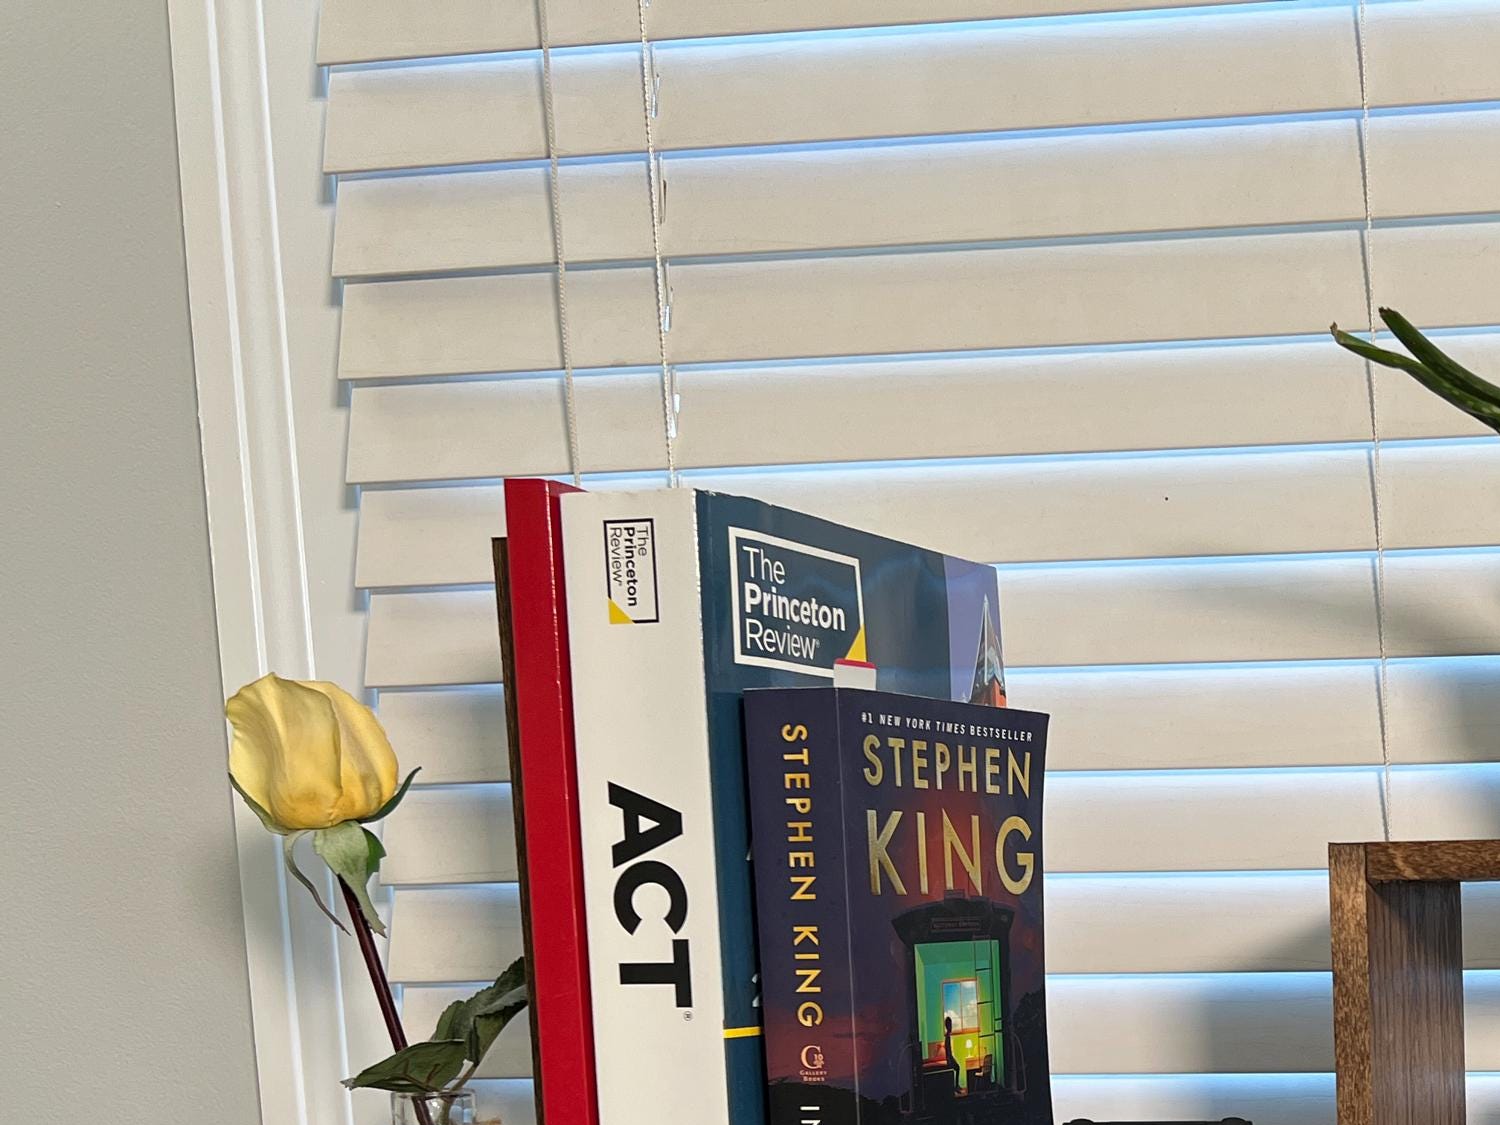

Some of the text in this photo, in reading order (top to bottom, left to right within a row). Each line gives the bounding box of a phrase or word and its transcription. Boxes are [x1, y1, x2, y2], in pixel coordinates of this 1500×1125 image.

[609, 527, 624, 583] Review
[624, 527, 638, 607] Princeton
[637, 526, 649, 556] The
[742, 546, 786, 584] The
[744, 582, 846, 631] Princeton
[745, 618, 816, 660] Review
[861, 712, 1033, 742] #1 NEW YORK TIMES BESTSELLER
[863, 734, 1031, 799] STEPHEN
[781, 724, 824, 1027] STEPHEN KING
[867, 808, 1034, 896] KING
[607, 781, 693, 1008] ACT
